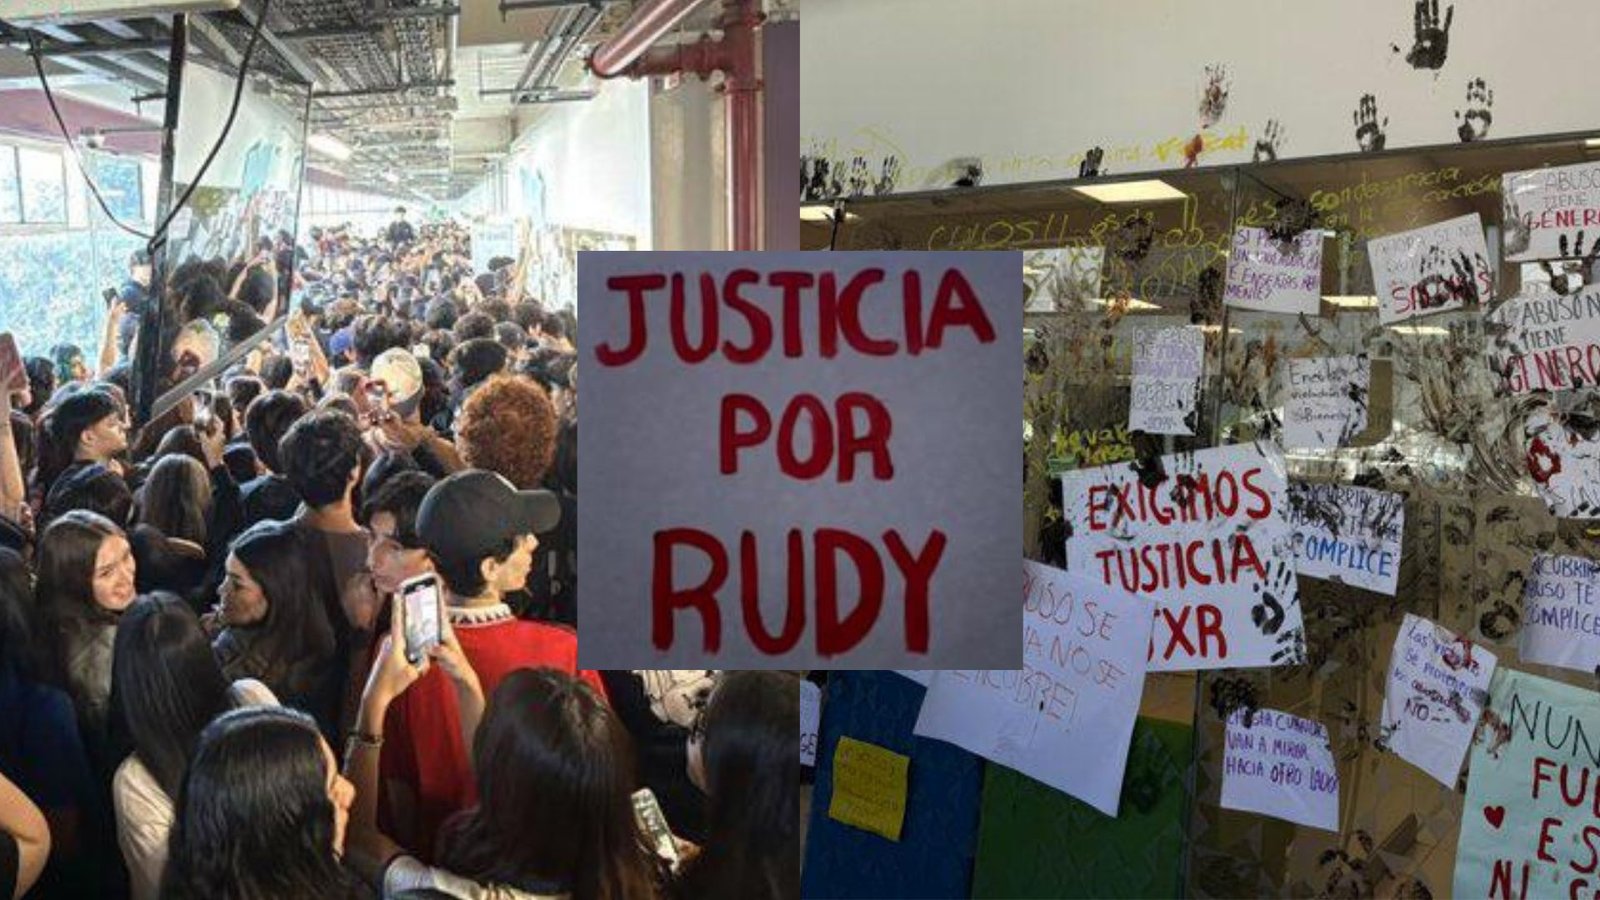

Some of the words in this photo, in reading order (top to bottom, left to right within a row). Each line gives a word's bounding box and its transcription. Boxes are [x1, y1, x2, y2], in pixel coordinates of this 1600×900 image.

[1522, 208, 1600, 230] GENER
[595, 268, 996, 367] JUSTICIA
[720, 392, 894, 483] POR
[652, 528, 947, 657] RUDY
[1147, 603, 1228, 662] XR
[1226, 756, 1264, 777] HACIA
